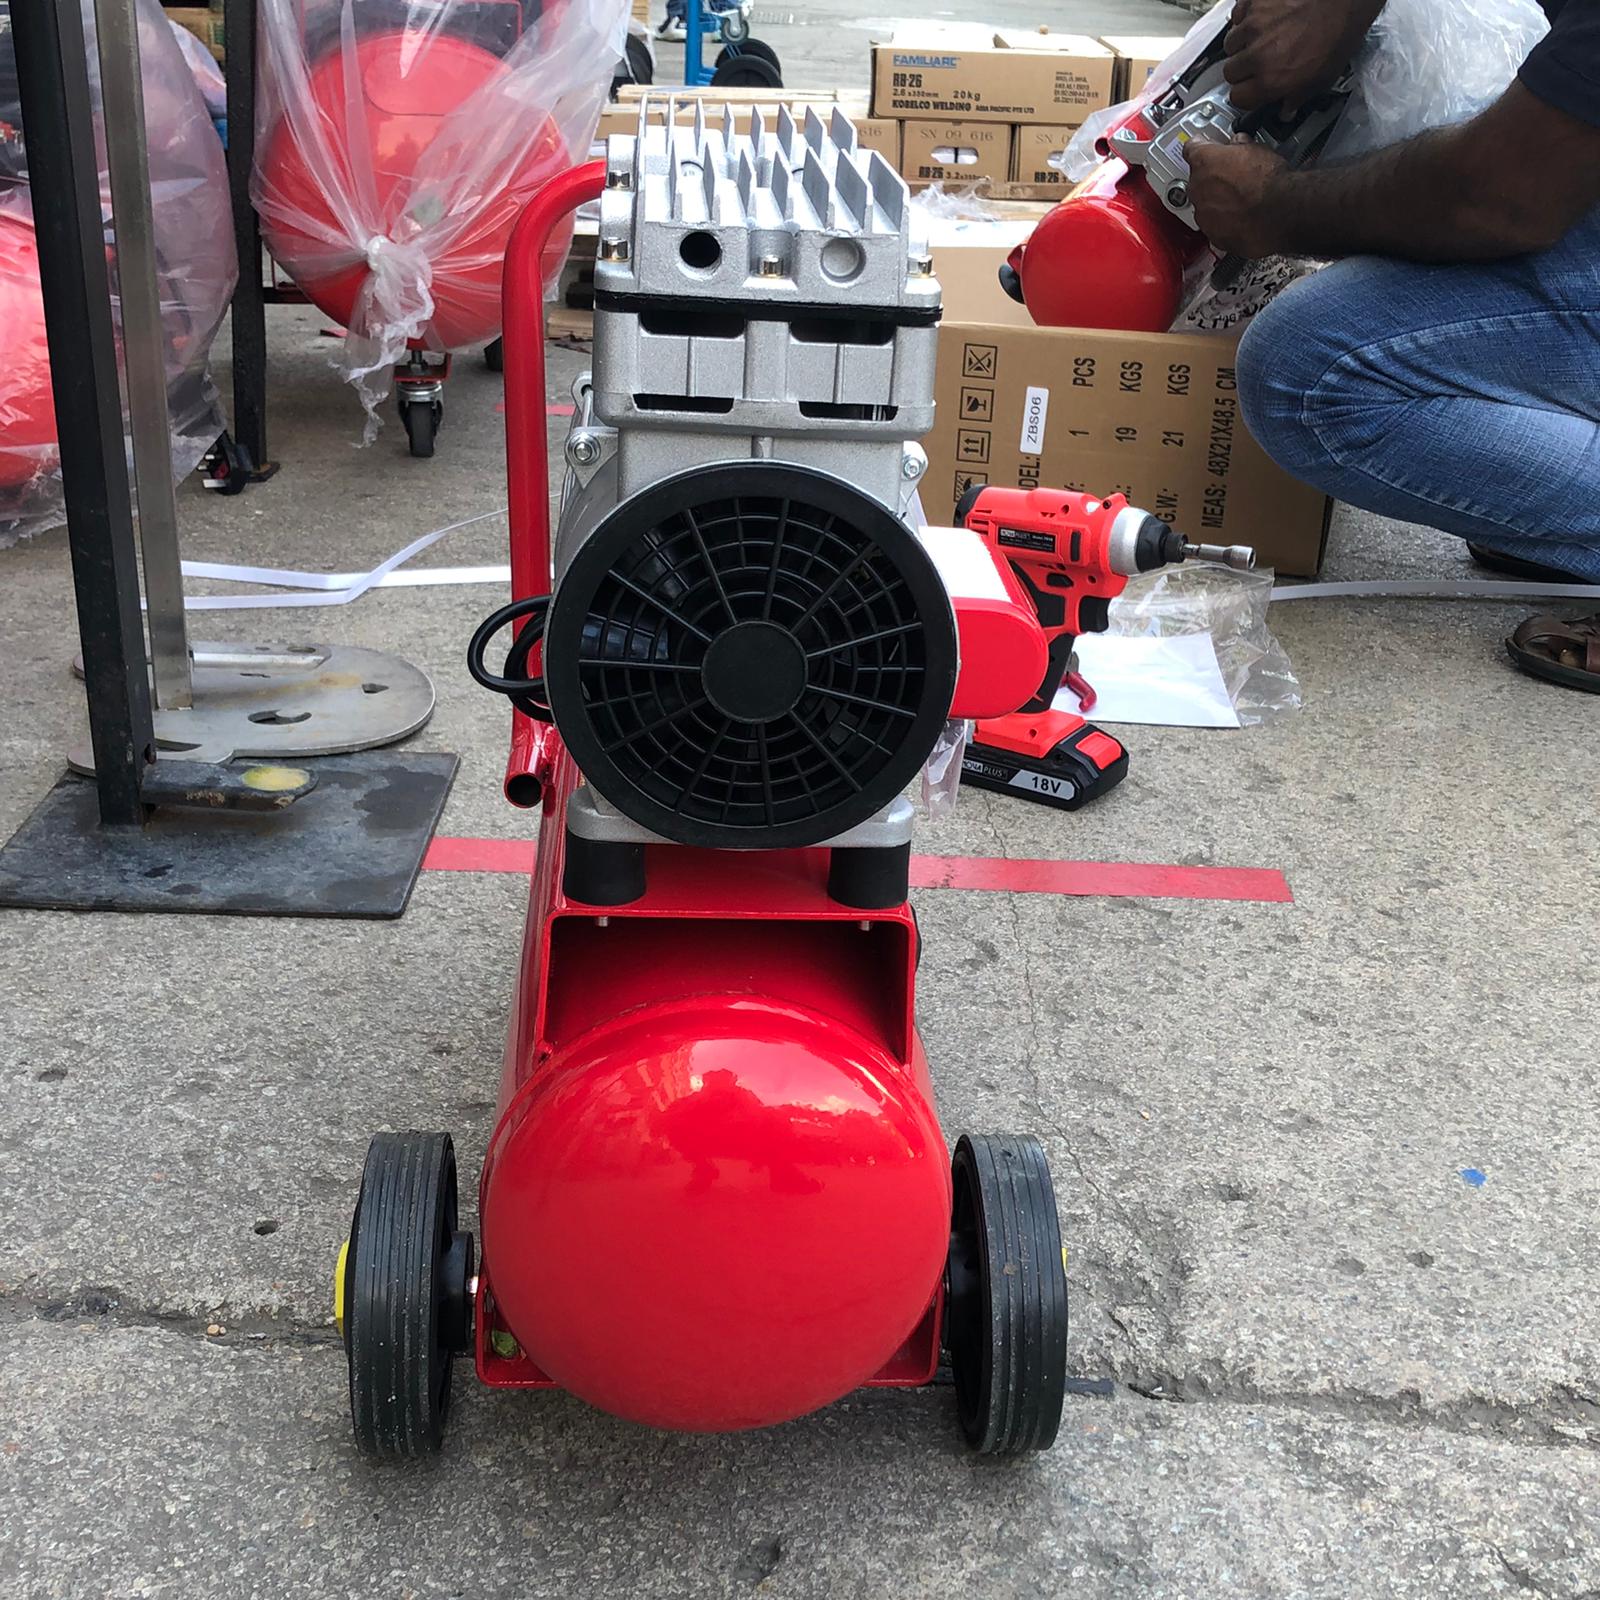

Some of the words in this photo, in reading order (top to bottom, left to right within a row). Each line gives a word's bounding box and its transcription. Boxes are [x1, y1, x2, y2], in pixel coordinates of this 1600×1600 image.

[892, 73, 923, 88] RB-26
[892, 100, 931, 110] KOBELCO
[933, 101, 971, 112] WELDING
[920, 128, 937, 139] SN
[945, 129, 962, 140] 09
[970, 131, 993, 142] 616
[1035, 133, 1053, 144] SN
[919, 166, 944, 179] RB-26
[1034, 171, 1059, 183] RB-26
[1072, 356, 1096, 388] PCS
[1119, 360, 1143, 393] KGS
[1167, 363, 1191, 395] KGS
[1216, 367, 1236, 390] CM
[1027, 396, 1041, 444] ZBS06
[1069, 429, 1090, 437] 1
[1115, 426, 1137, 442] 19
[1162, 429, 1184, 448] 21
[1207, 397, 1237, 477] 48X21X48.5
[1018, 456, 1041, 489] DEL:
[1201, 484, 1227, 528] MEAS:
[1032, 776, 1062, 794] 18V
